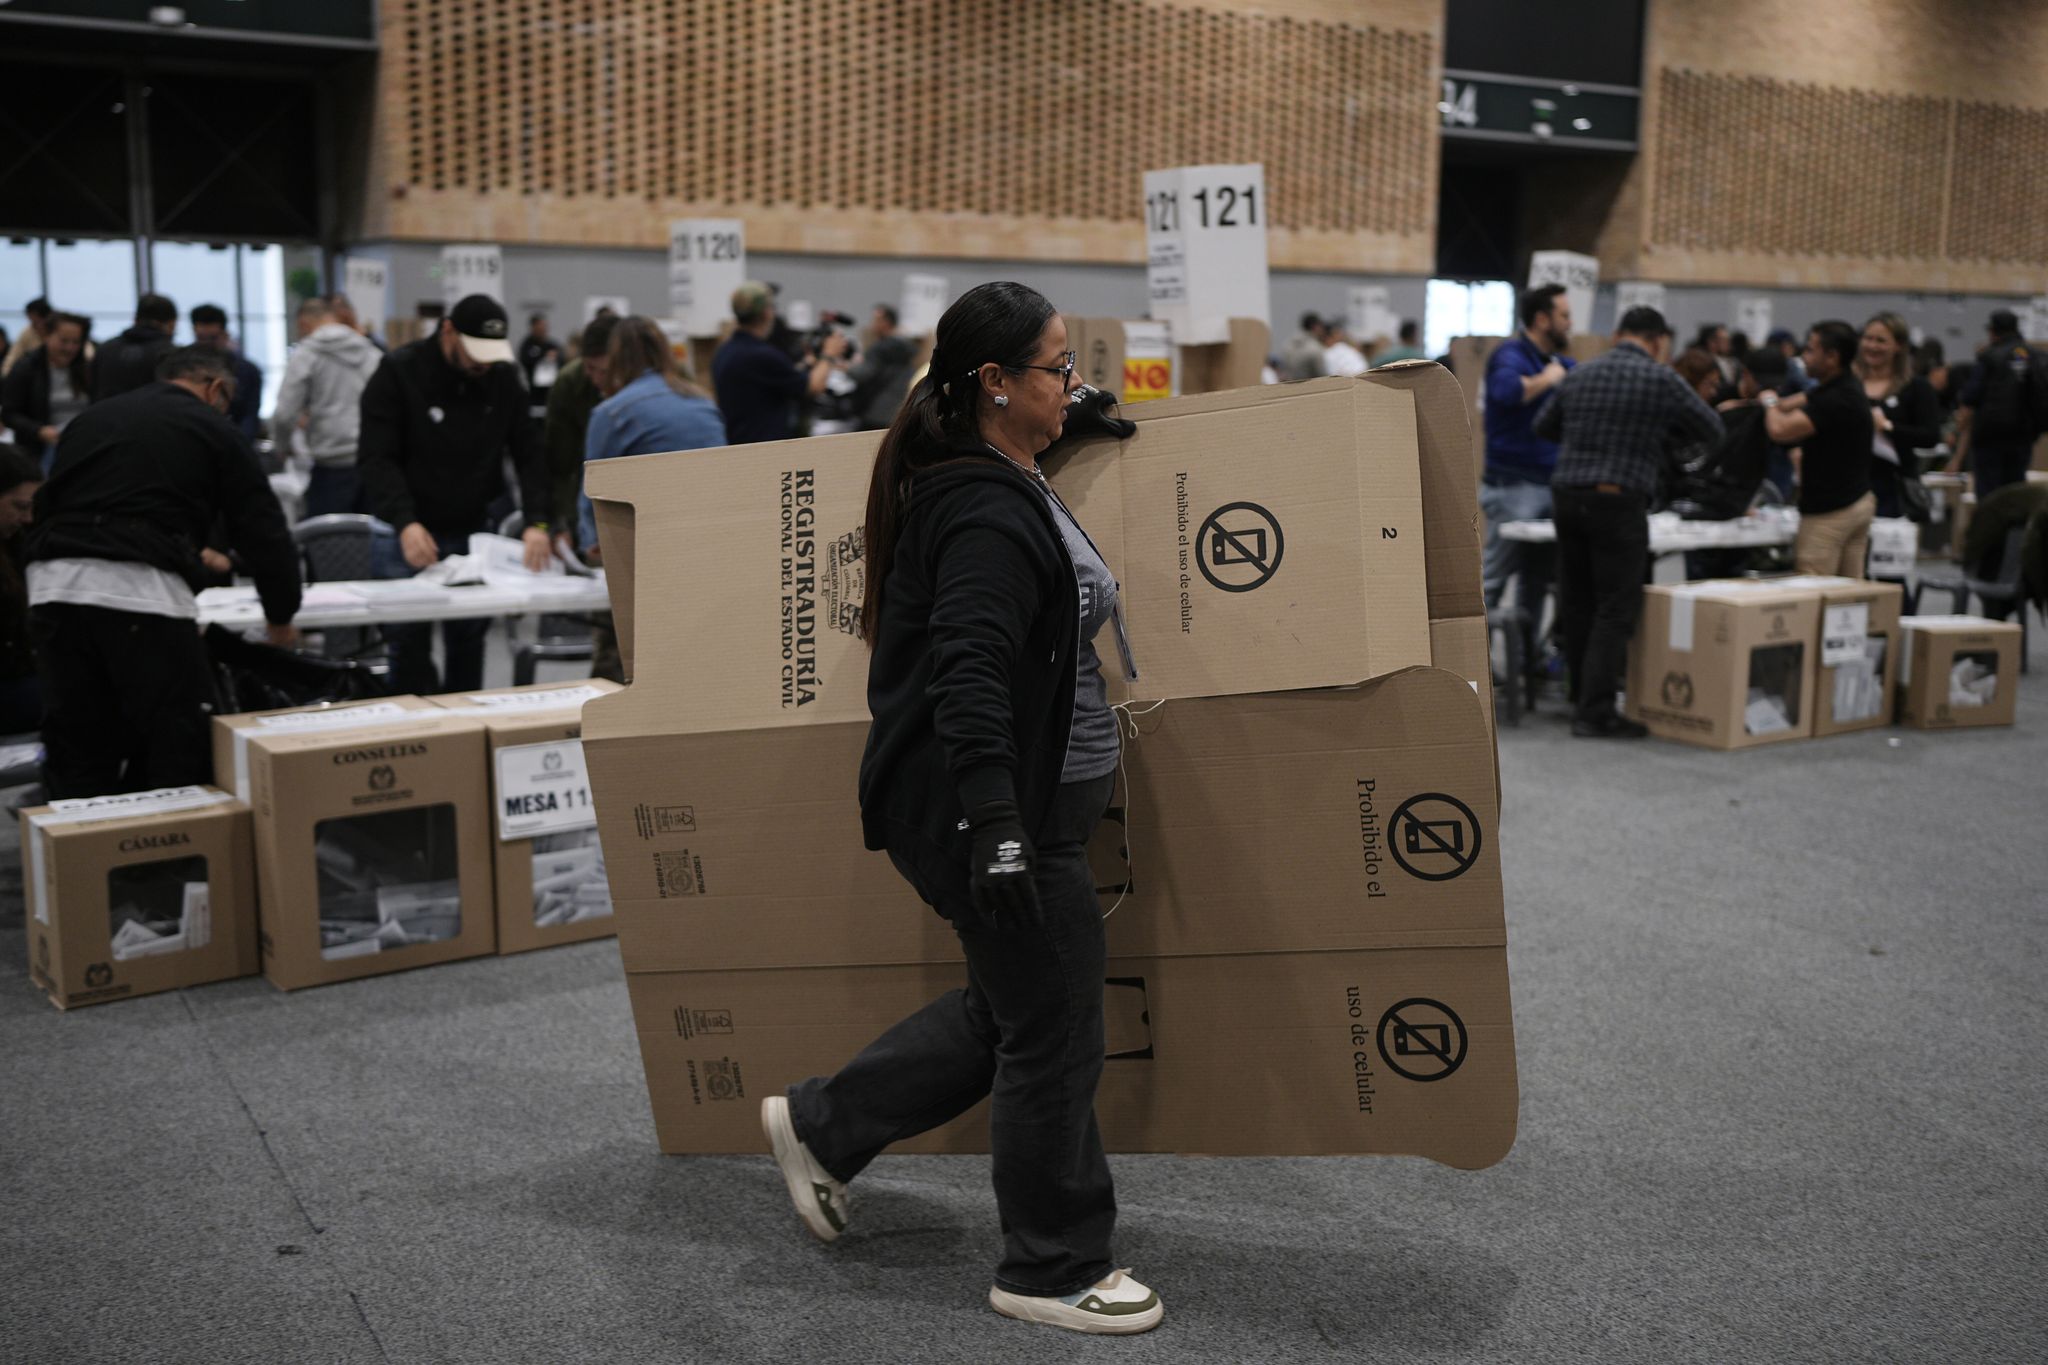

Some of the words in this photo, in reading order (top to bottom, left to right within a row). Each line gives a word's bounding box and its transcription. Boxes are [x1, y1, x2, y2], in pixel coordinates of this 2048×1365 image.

[1146, 190, 1180, 232] 121
[1191, 185, 1257, 228] 121
[697, 231, 740, 261] 120
[1122, 363, 1170, 390] NO
[781, 471, 793, 553] NACIONAL
[1176, 472, 1190, 532] Prohibido
[1178, 534, 1190, 547] el
[1382, 527, 1398, 539] 2
[781, 557, 793, 591] DEL
[830, 544, 840, 590] ORGANIZACIÓN
[1179, 548, 1189, 571] uso
[796, 469, 823, 708] REGISTRADURÍA
[1180, 573, 1191, 589] de
[830, 591, 839, 626] ELECTORAL
[1181, 592, 1193, 634] celular
[781, 594, 793, 660] ESTADO
[781, 664, 794, 709] CIVIL
[333, 742, 428, 765] CONSULTAS
[505, 791, 559, 817] MESA
[119, 833, 191, 853] CÁMARA
[1357, 778, 1383, 875] Prohibido
[1367, 881, 1386, 898] el
[1346, 985, 1362, 1018] uso
[1351, 1023, 1370, 1046] de
[1354, 1051, 1376, 1114] celular
